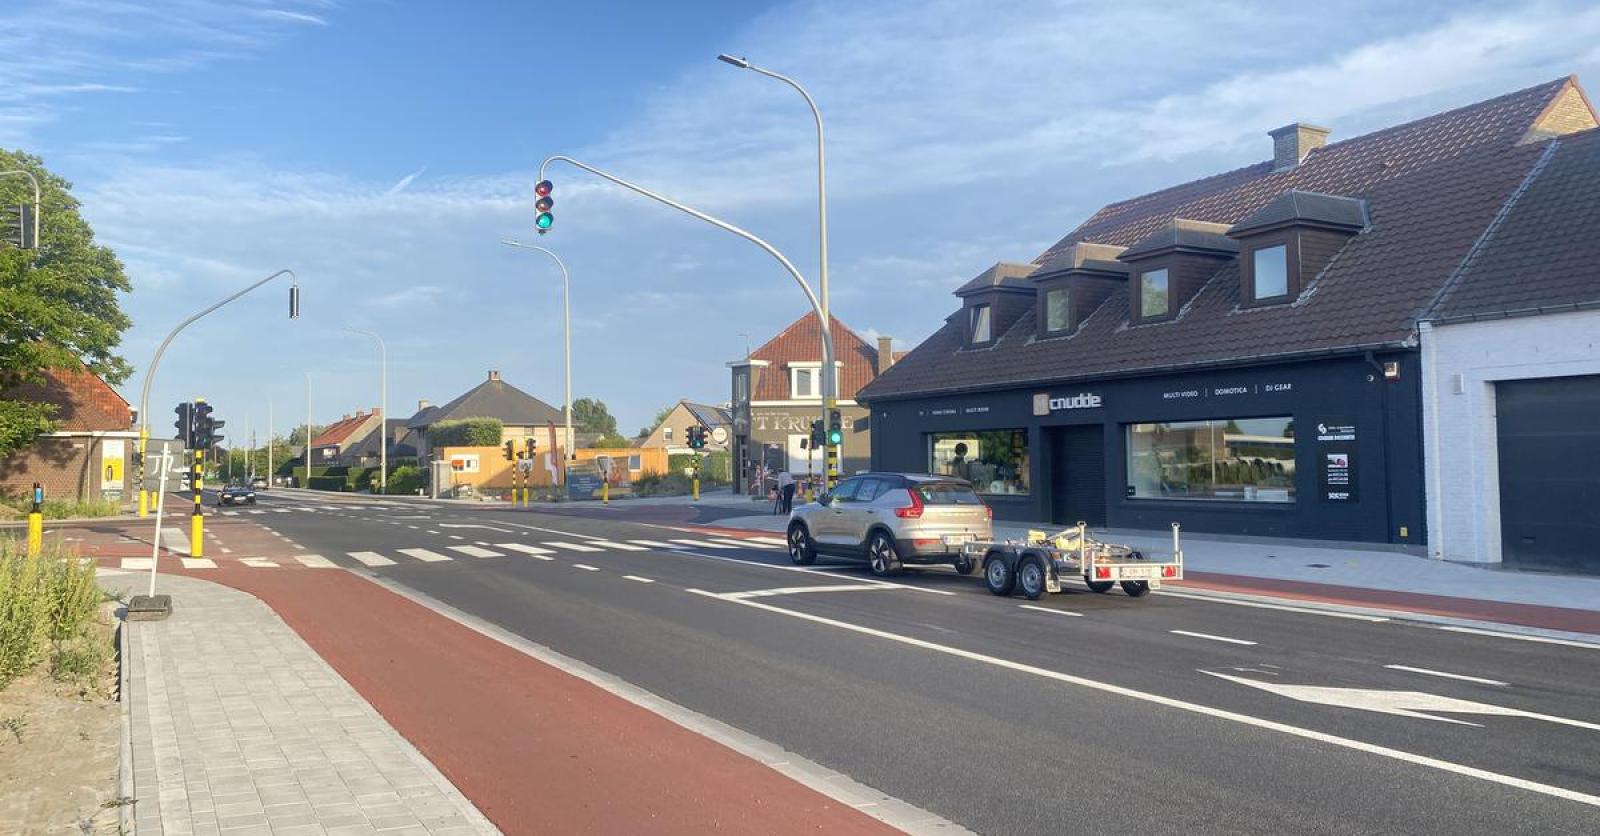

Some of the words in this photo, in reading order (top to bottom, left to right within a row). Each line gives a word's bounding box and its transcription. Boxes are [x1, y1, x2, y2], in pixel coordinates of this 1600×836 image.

[1181, 390, 1199, 398] VIDEO
[1214, 387, 1248, 396] DOMOTICA
[1274, 383, 1292, 391] GEAR
[1049, 392, 1102, 410] cnudde
